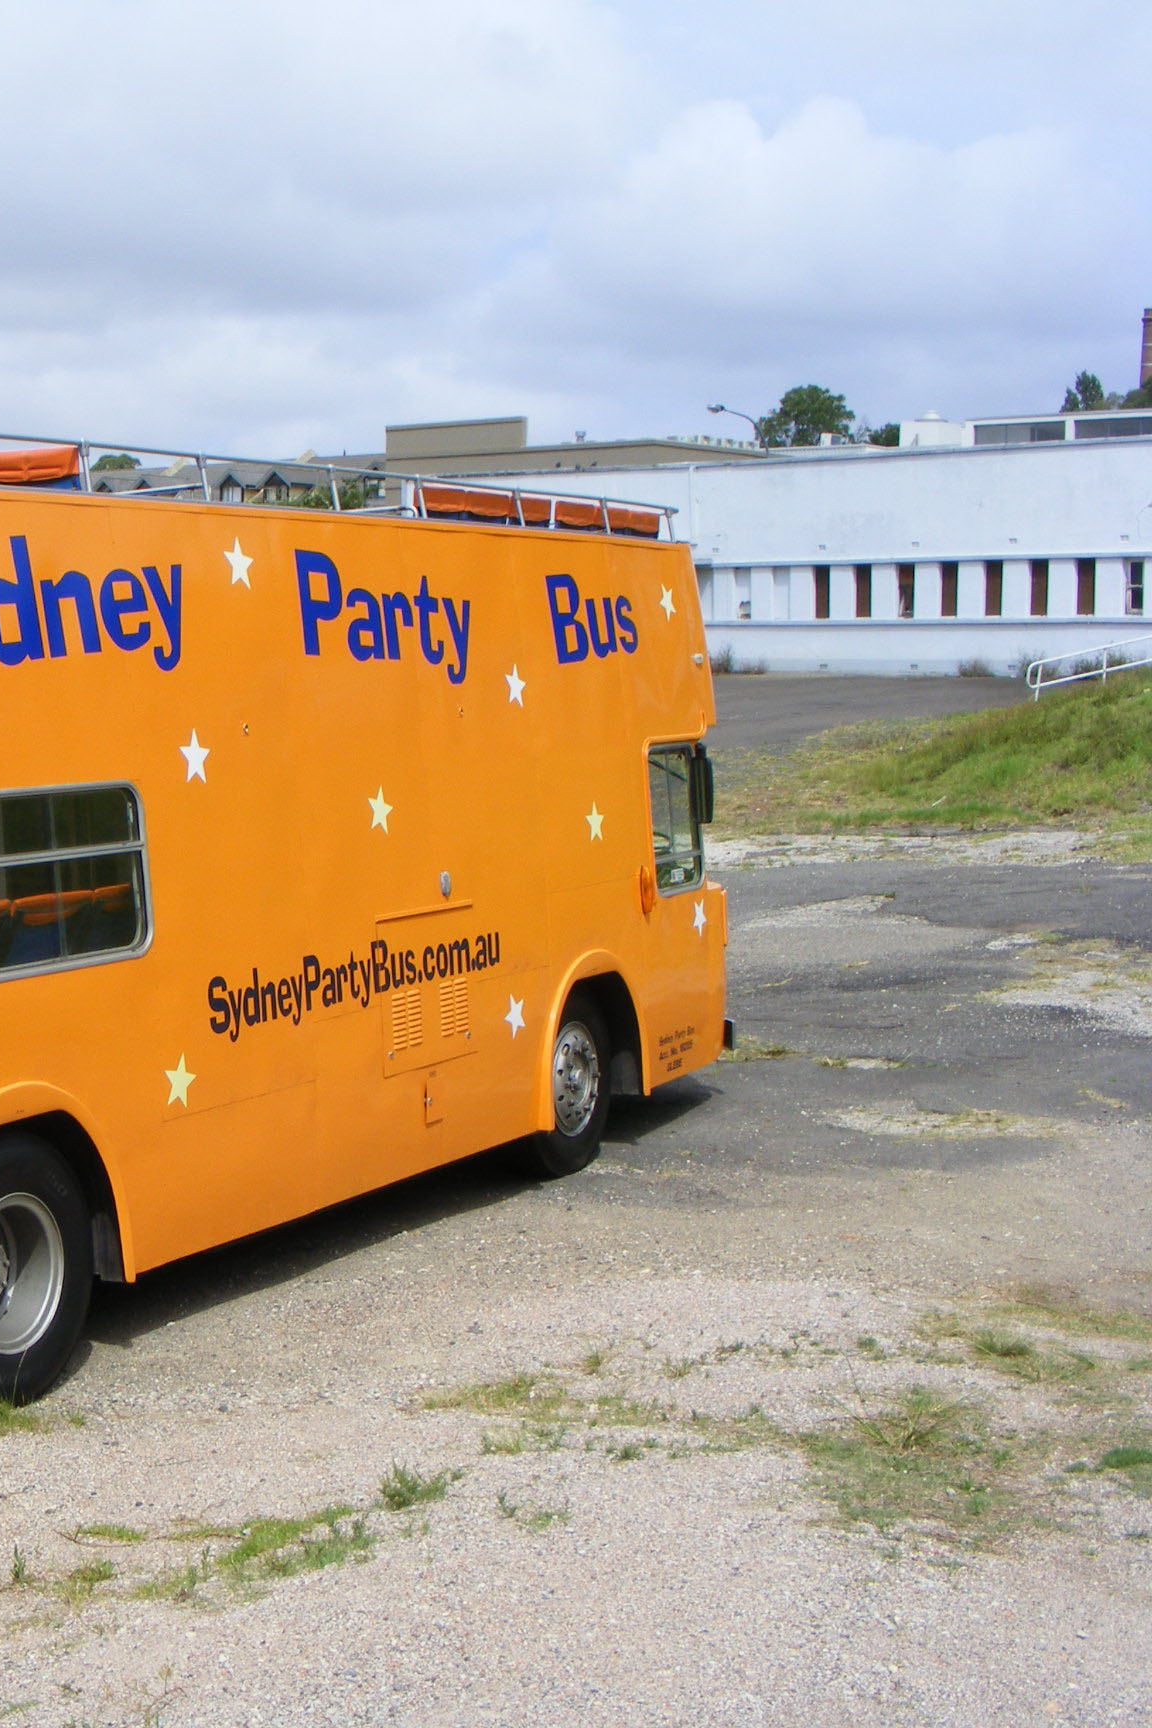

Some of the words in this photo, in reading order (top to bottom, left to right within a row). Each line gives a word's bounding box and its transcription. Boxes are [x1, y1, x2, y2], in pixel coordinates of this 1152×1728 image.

[294, 549, 471, 685] Party
[545, 574, 639, 665] Bus
[207, 931, 500, 1043] SydneyPartyBus.com.au
